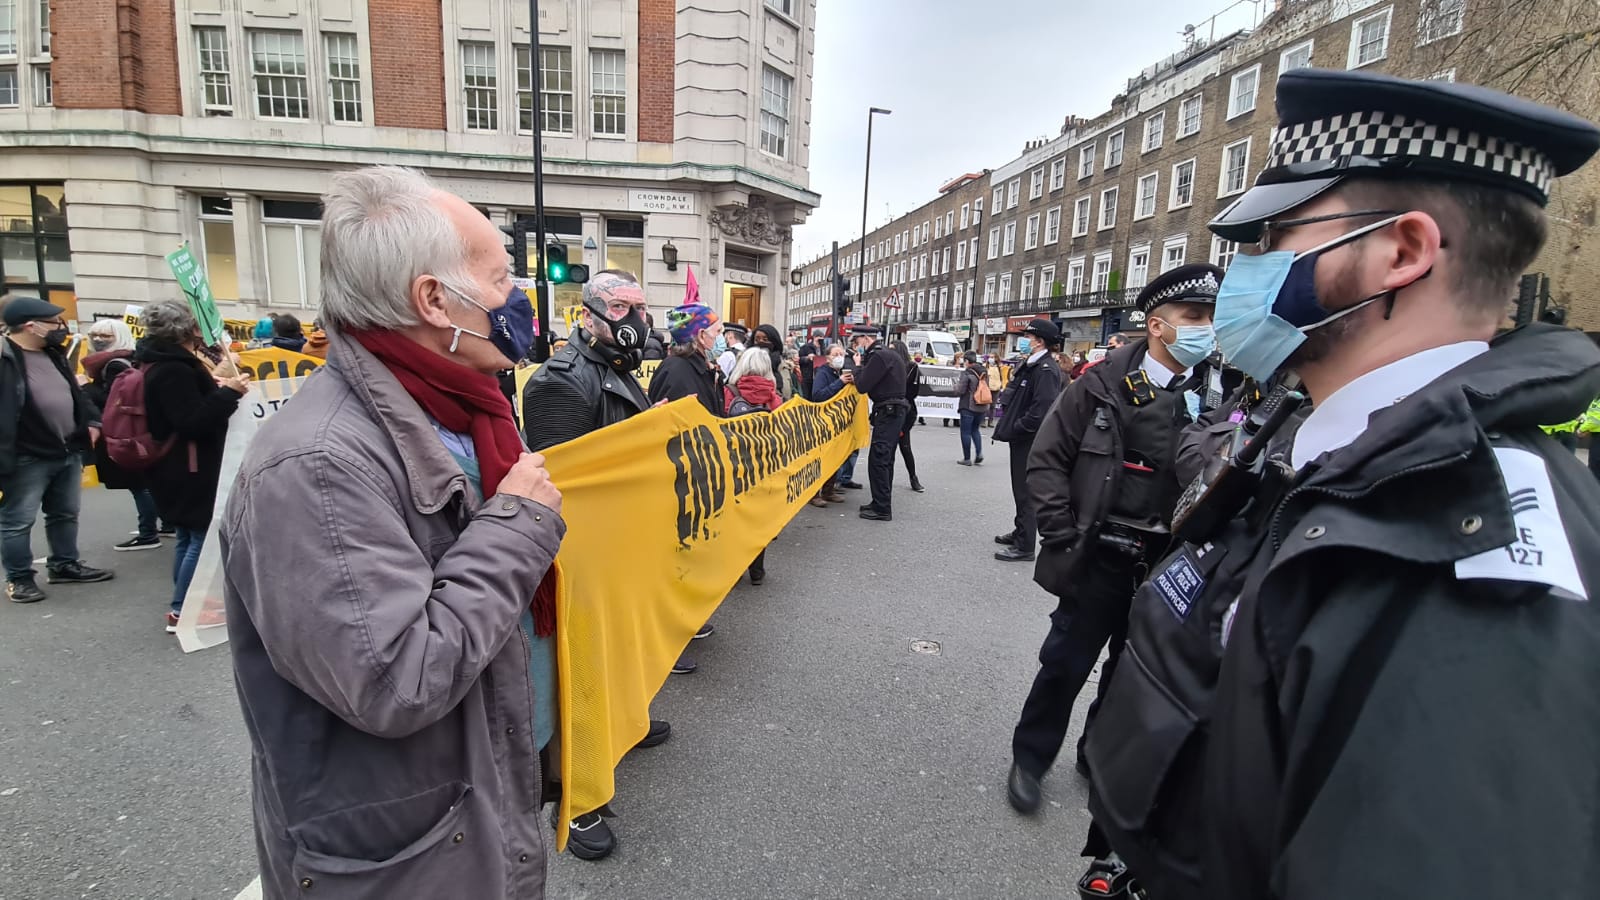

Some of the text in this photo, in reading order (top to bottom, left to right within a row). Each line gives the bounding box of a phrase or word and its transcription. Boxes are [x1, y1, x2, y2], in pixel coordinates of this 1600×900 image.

[637, 193, 687, 202] CROWNDALE
[926, 375, 960, 386] INCINERA
[666, 424, 725, 541] END
[719, 404, 832, 497] ENVIRONMENTAL
[1505, 545, 1543, 566] 127
[1175, 571, 1191, 592] POLICE
